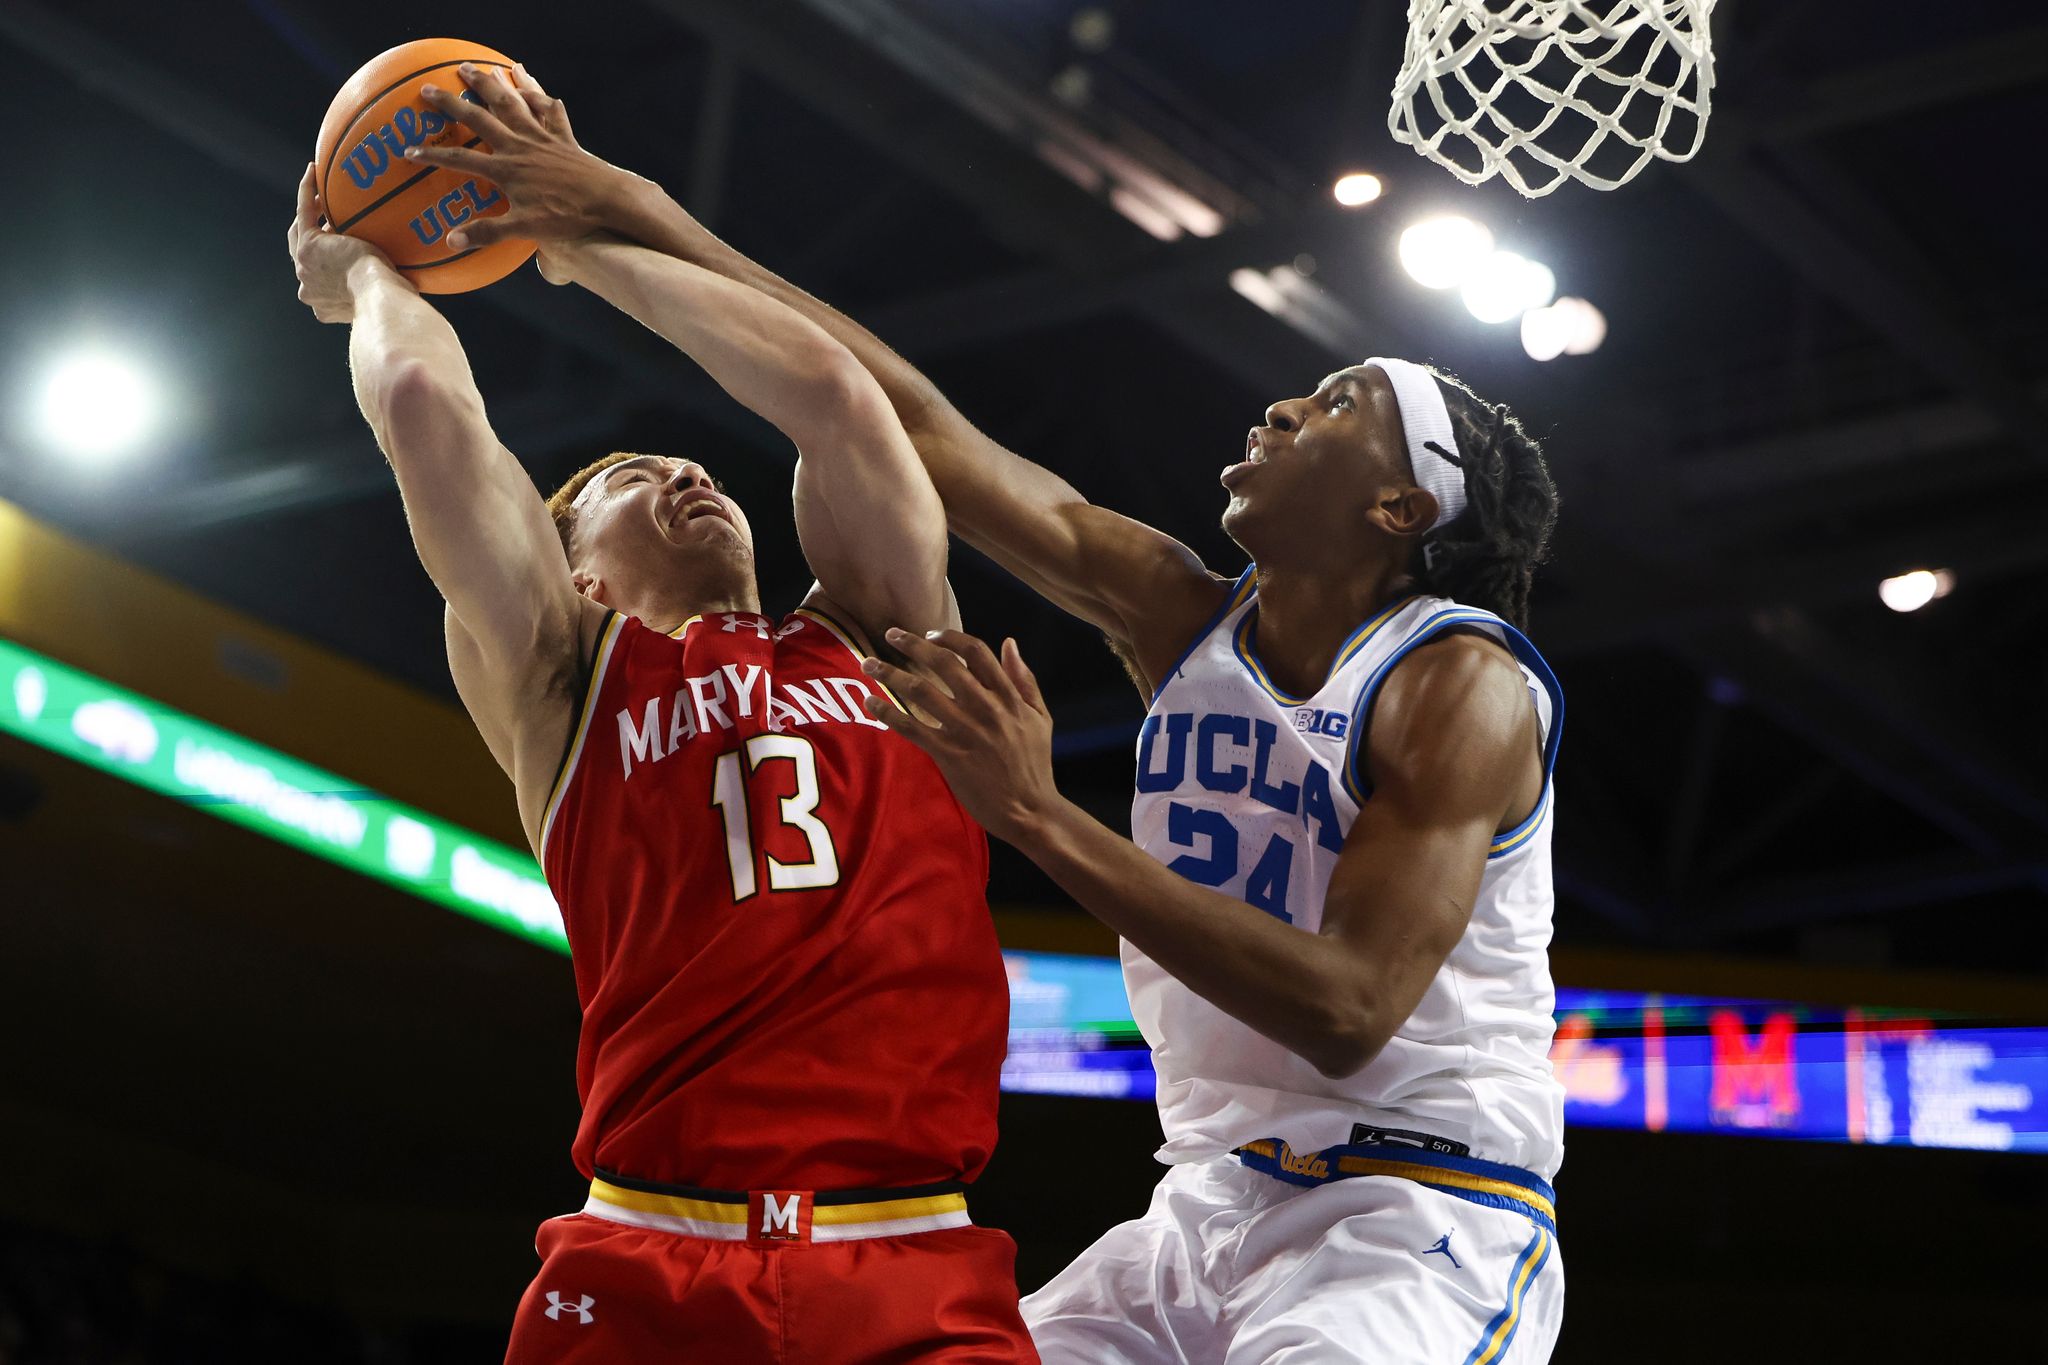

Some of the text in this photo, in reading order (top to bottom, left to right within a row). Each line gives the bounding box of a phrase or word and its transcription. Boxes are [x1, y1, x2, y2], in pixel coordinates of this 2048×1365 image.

[408, 179, 501, 246] UCL
[616, 664, 889, 782] MARYLAND
[712, 733, 840, 905] 13
[1136, 713, 1345, 855] UCLA
[1166, 801, 1294, 925] 24
[1432, 1140, 1451, 1153] 50
[760, 1193, 801, 1235] M
